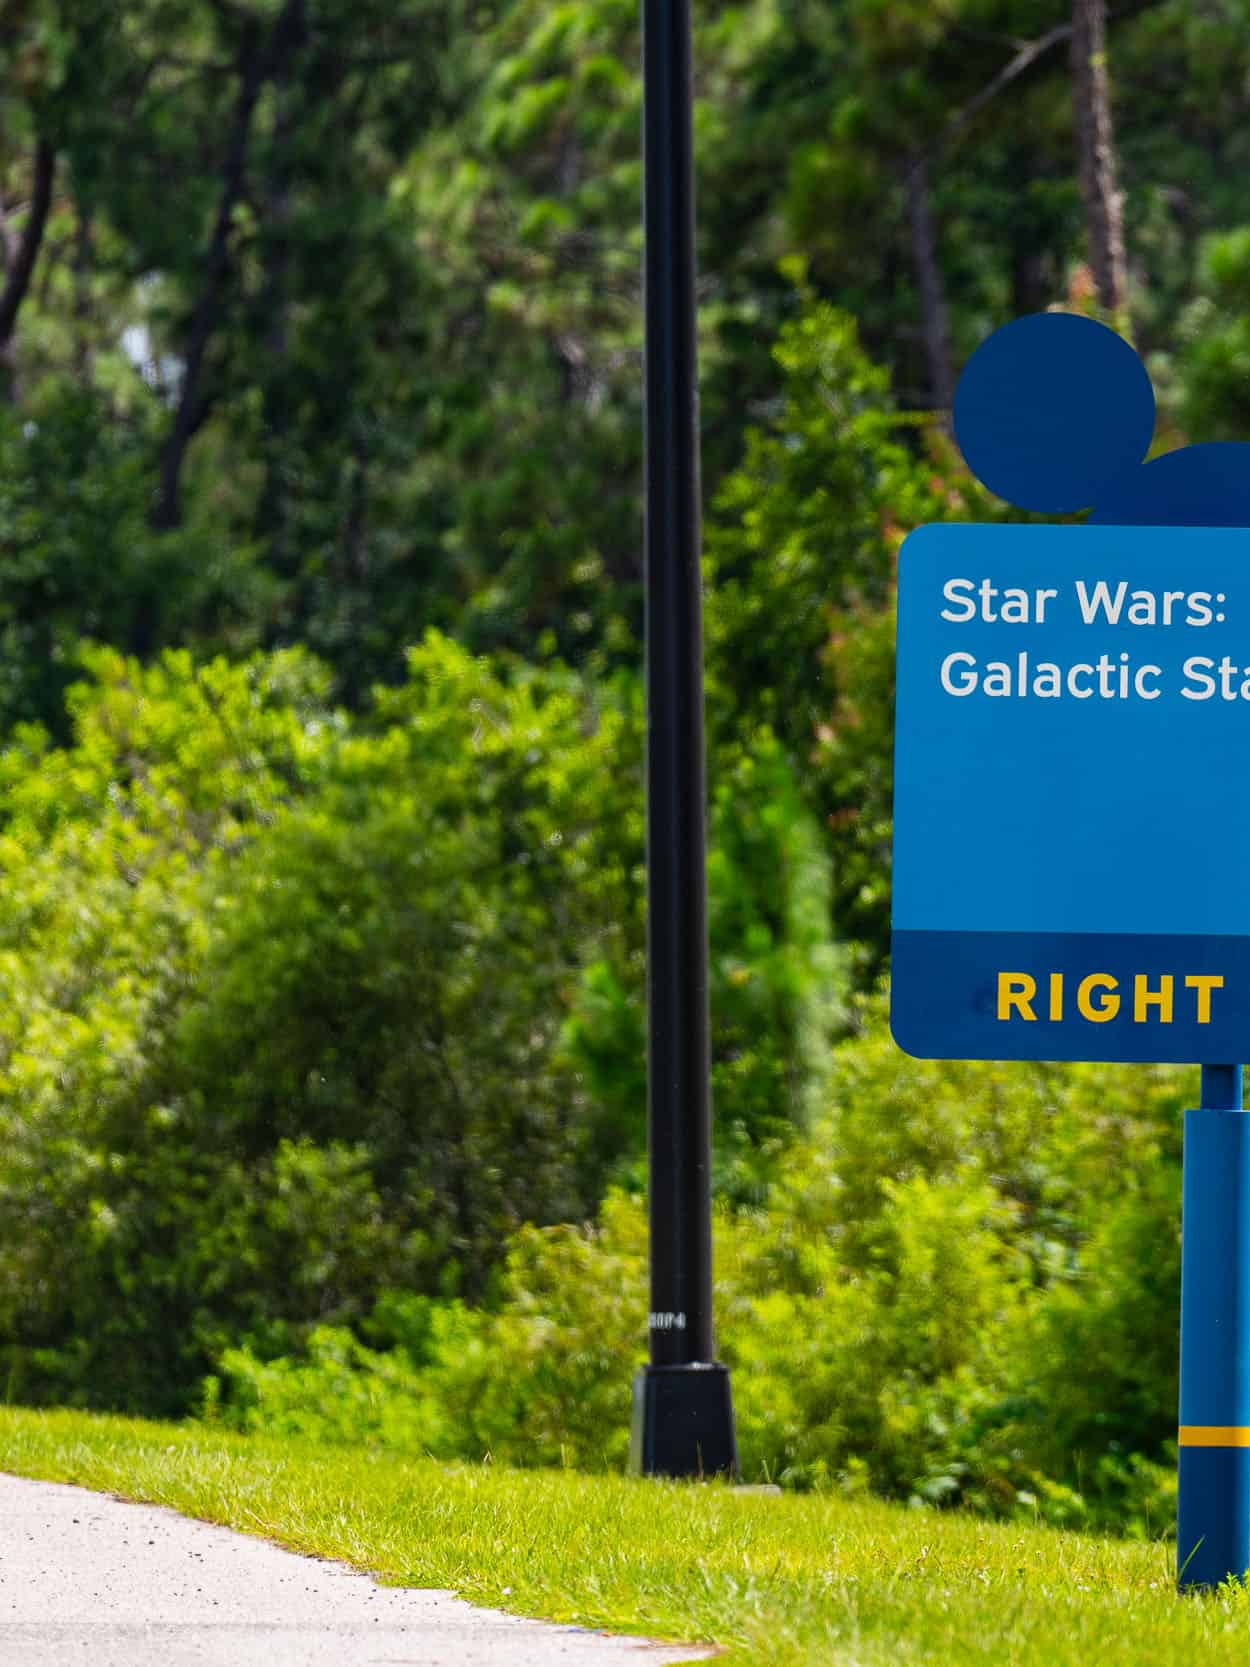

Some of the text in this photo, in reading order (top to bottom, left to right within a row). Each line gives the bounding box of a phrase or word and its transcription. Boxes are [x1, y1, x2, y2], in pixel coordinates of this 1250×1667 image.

[941, 578, 1227, 626] Star Wars:
[940, 651, 1162, 700] Galactic
[997, 972, 1224, 1024] RIGHT
